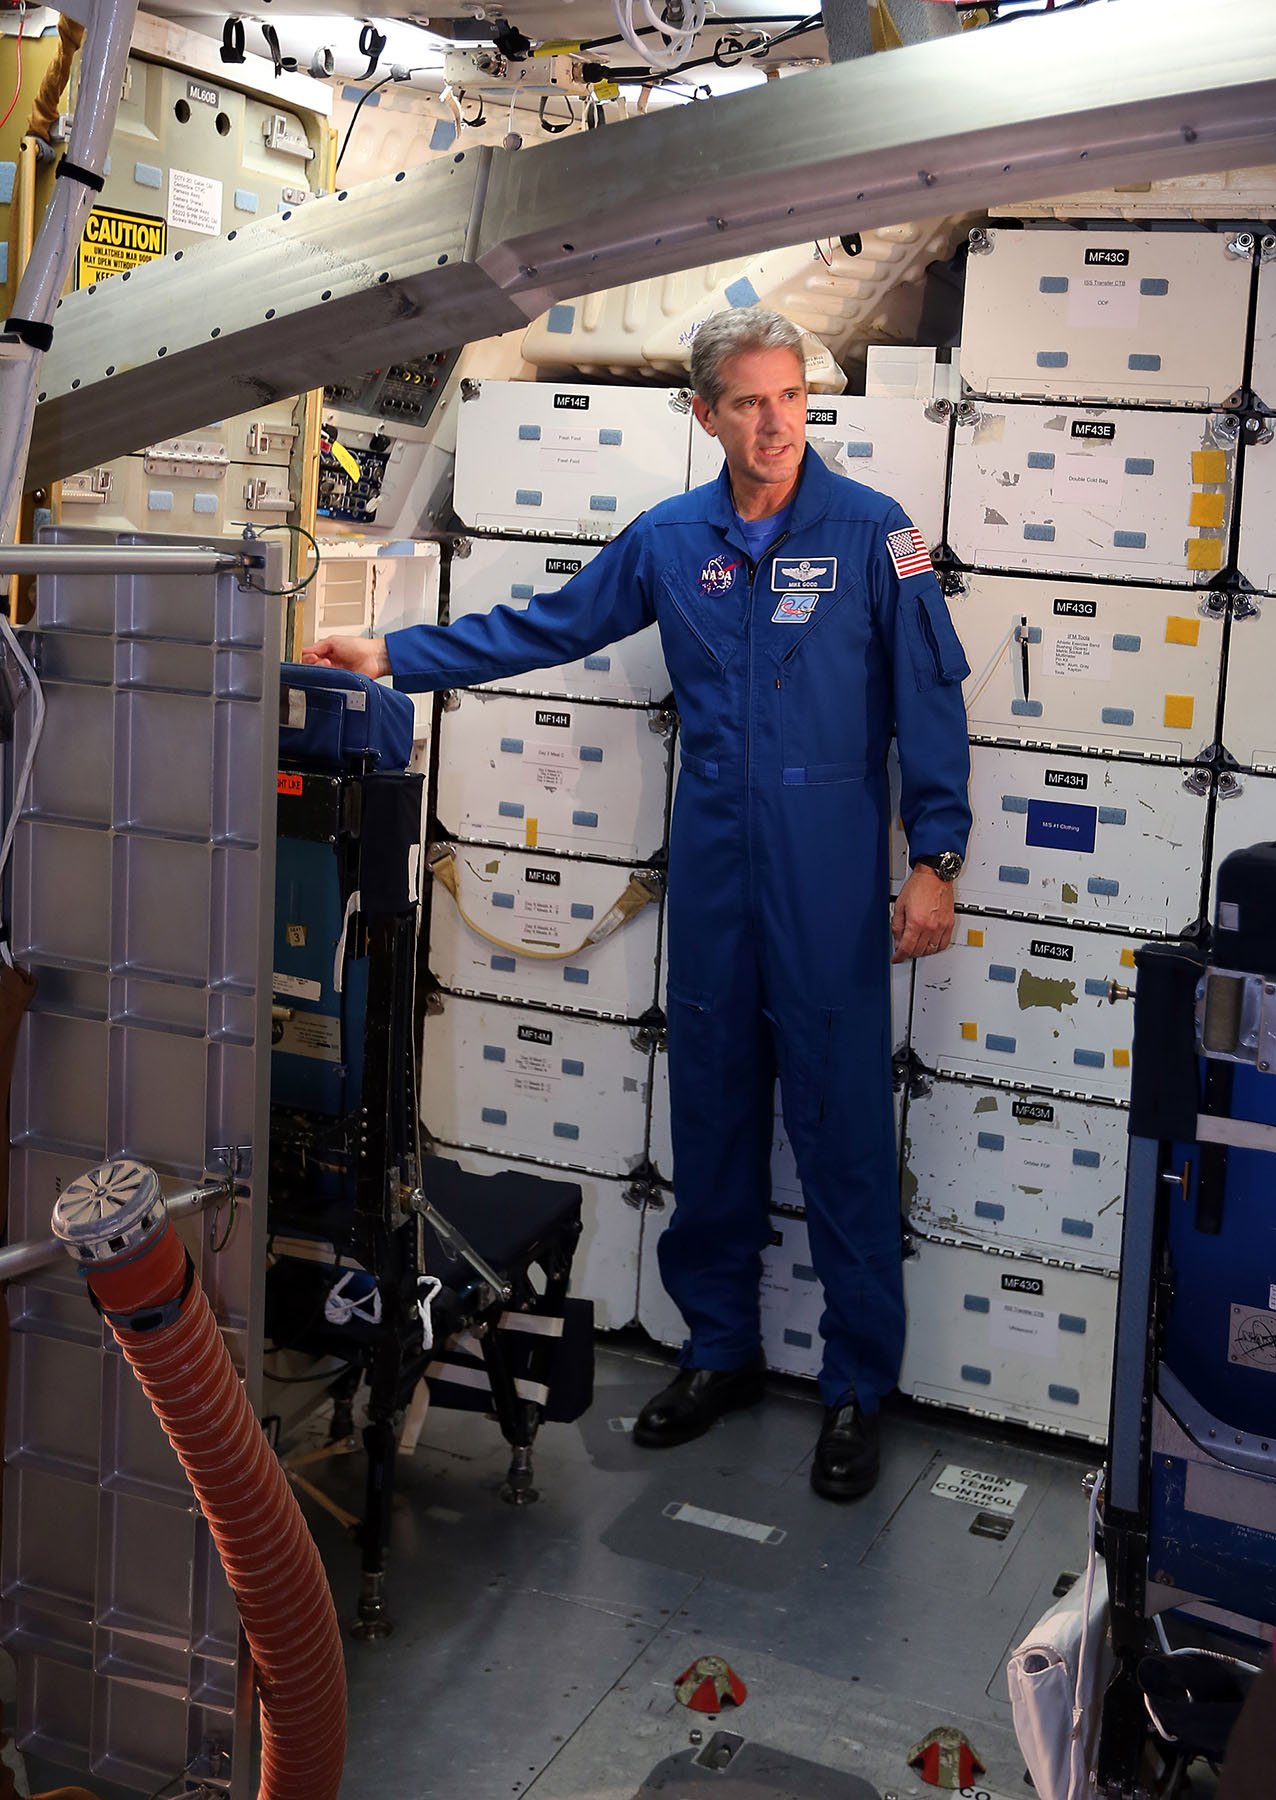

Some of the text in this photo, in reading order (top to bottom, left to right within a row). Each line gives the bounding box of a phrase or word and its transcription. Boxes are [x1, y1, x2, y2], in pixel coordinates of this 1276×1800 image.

[190, 86, 216, 104] ML60B
[86, 215, 160, 252] CAUTION
[94, 246, 124, 259] UNLATCHED
[1088, 252, 1124, 263] MF43C
[84, 255, 136, 269] MAY OPEN WITHOUT
[557, 396, 586, 407] MF14E
[1075, 424, 1111, 436] MF43E
[548, 561, 578, 571] MF14G
[702, 569, 732, 581] NASA
[1056, 602, 1093, 614] MF43G
[538, 714, 567, 725] MF14H
[288, 780, 300, 789] LIKE
[1048, 773, 1084, 786] MF43H
[1060, 824, 1080, 832] Clothing
[528, 871, 557, 882] MF14K
[294, 932, 300, 942] 3
[1034, 943, 1069, 958] MF43K
[521, 1029, 550, 1042] MF14M
[1016, 1104, 1050, 1118] MF43M
[1004, 1277, 1040, 1291] MF43O
[960, 1470, 1012, 1487] CABIN
[961, 1479, 1004, 1493] TEMP
[936, 1482, 1015, 1508] CONTROL
